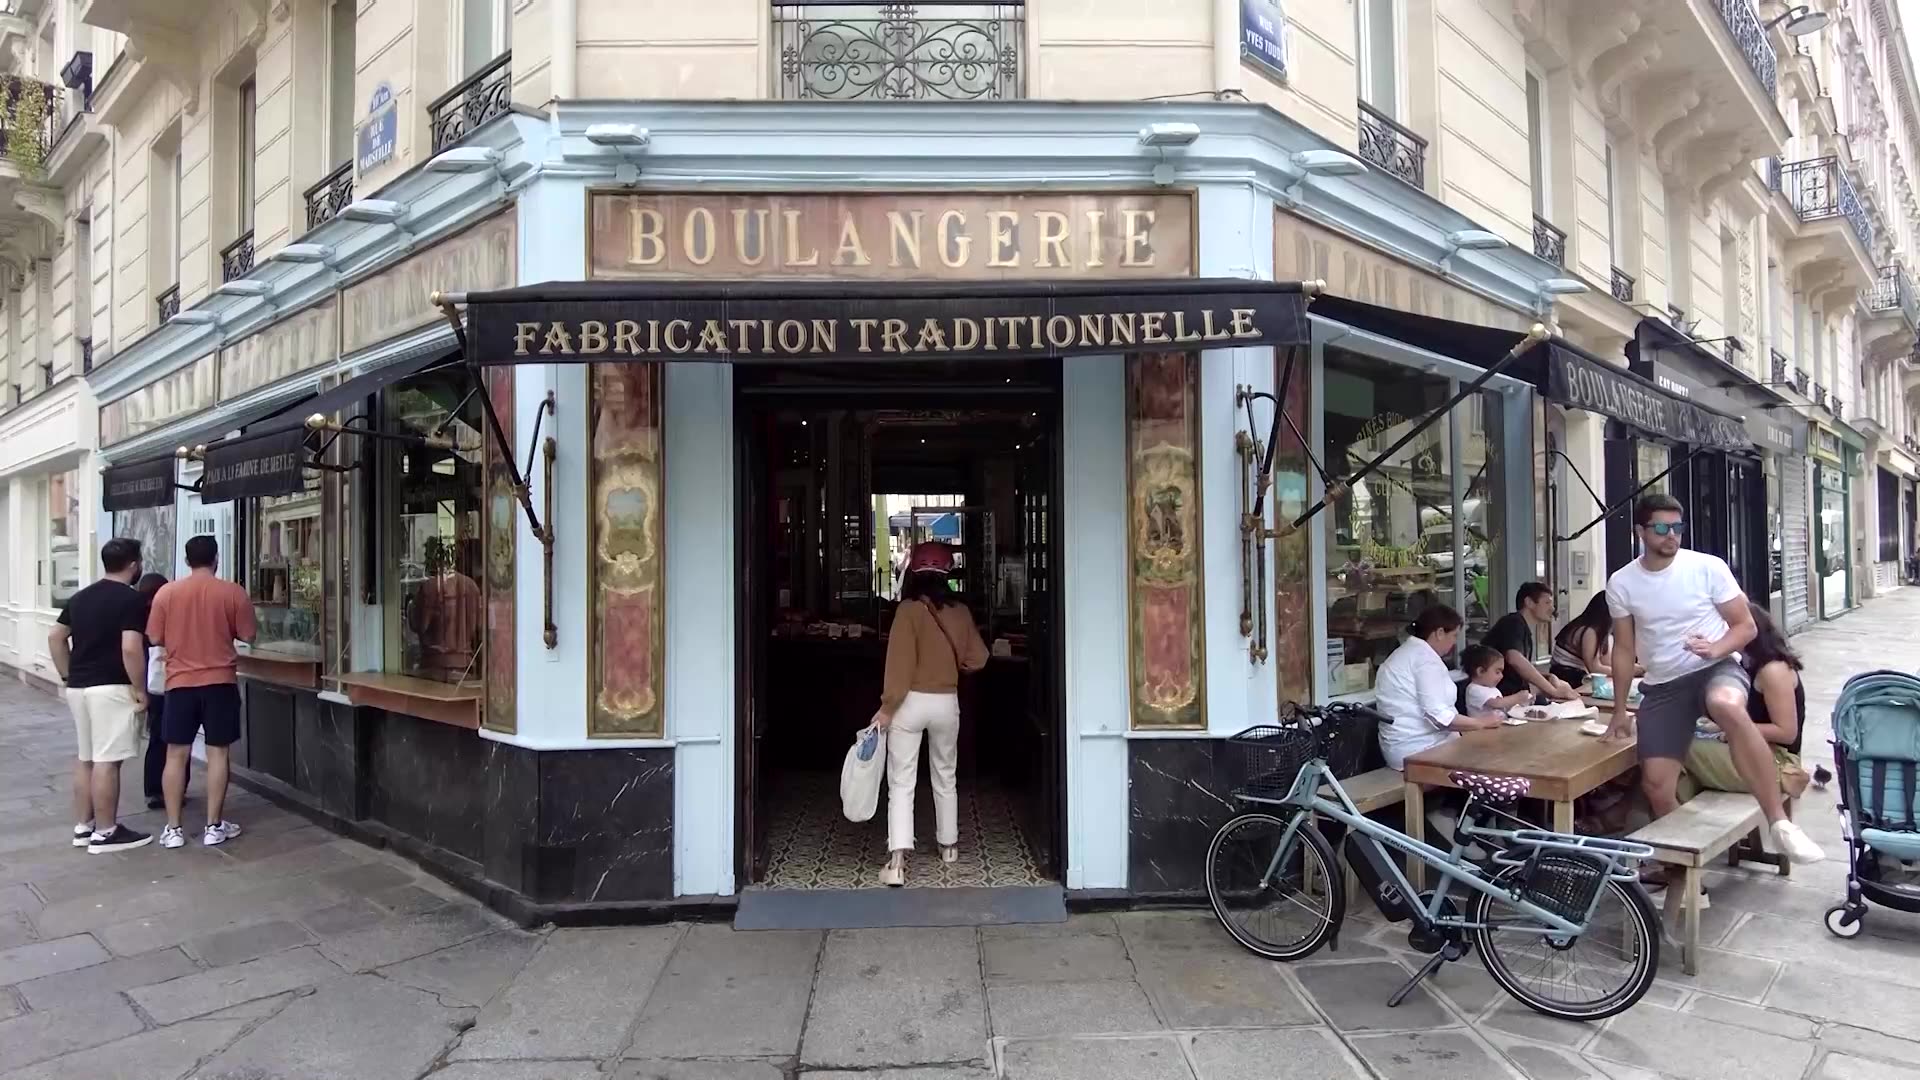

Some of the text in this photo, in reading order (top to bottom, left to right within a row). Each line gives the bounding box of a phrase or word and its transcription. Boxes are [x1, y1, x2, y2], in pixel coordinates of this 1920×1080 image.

[1246, 28, 1264, 50] YVES
[628, 206, 1157, 267] BOULANGERIE
[513, 308, 1263, 356] FABRICATION TRADITIONNELLE
[1566, 361, 1667, 430] BOULANGERIE
